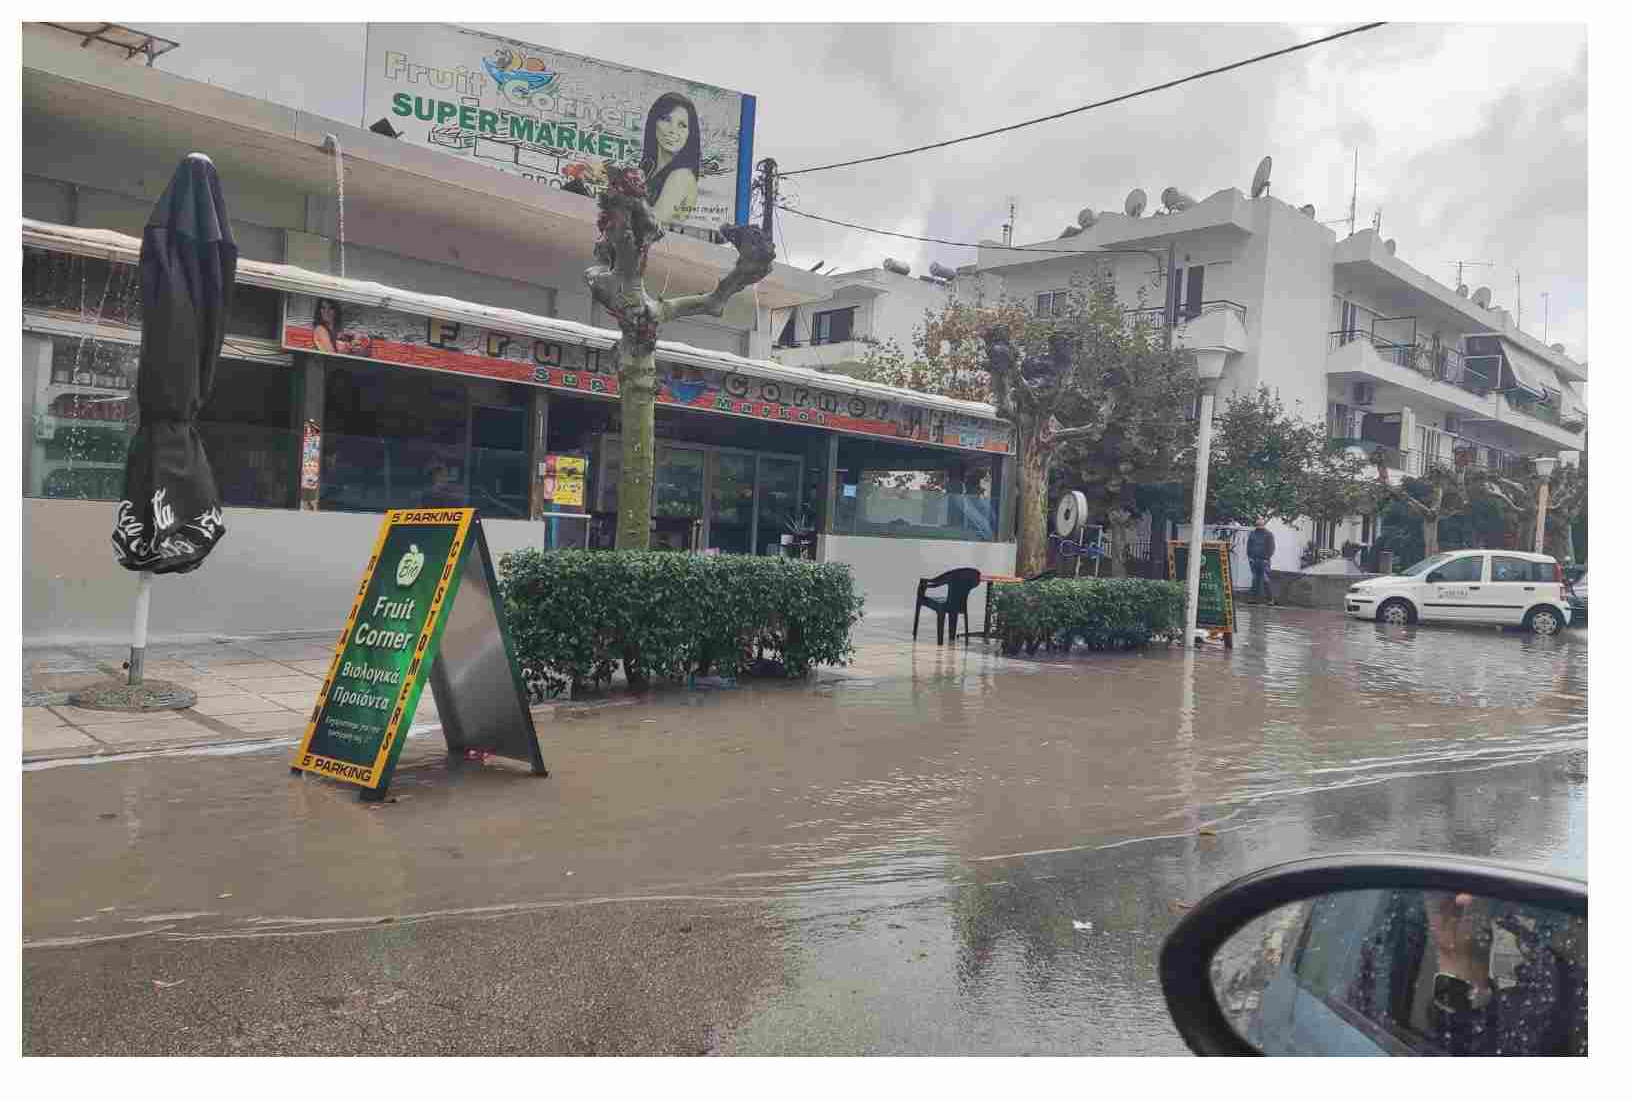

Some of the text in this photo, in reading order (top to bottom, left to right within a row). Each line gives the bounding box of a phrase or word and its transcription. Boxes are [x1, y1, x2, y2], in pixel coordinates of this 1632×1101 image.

[384, 50, 643, 135] Fruit Corner
[392, 92, 635, 161] SUPER MARKET
[427, 314, 600, 373] Frui
[405, 511, 464, 523] PARKING
[372, 595, 416, 620] Fruit
[354, 622, 414, 651] Corner
[342, 661, 401, 685] Βιολογικά
[314, 757, 372, 782] PARKING
